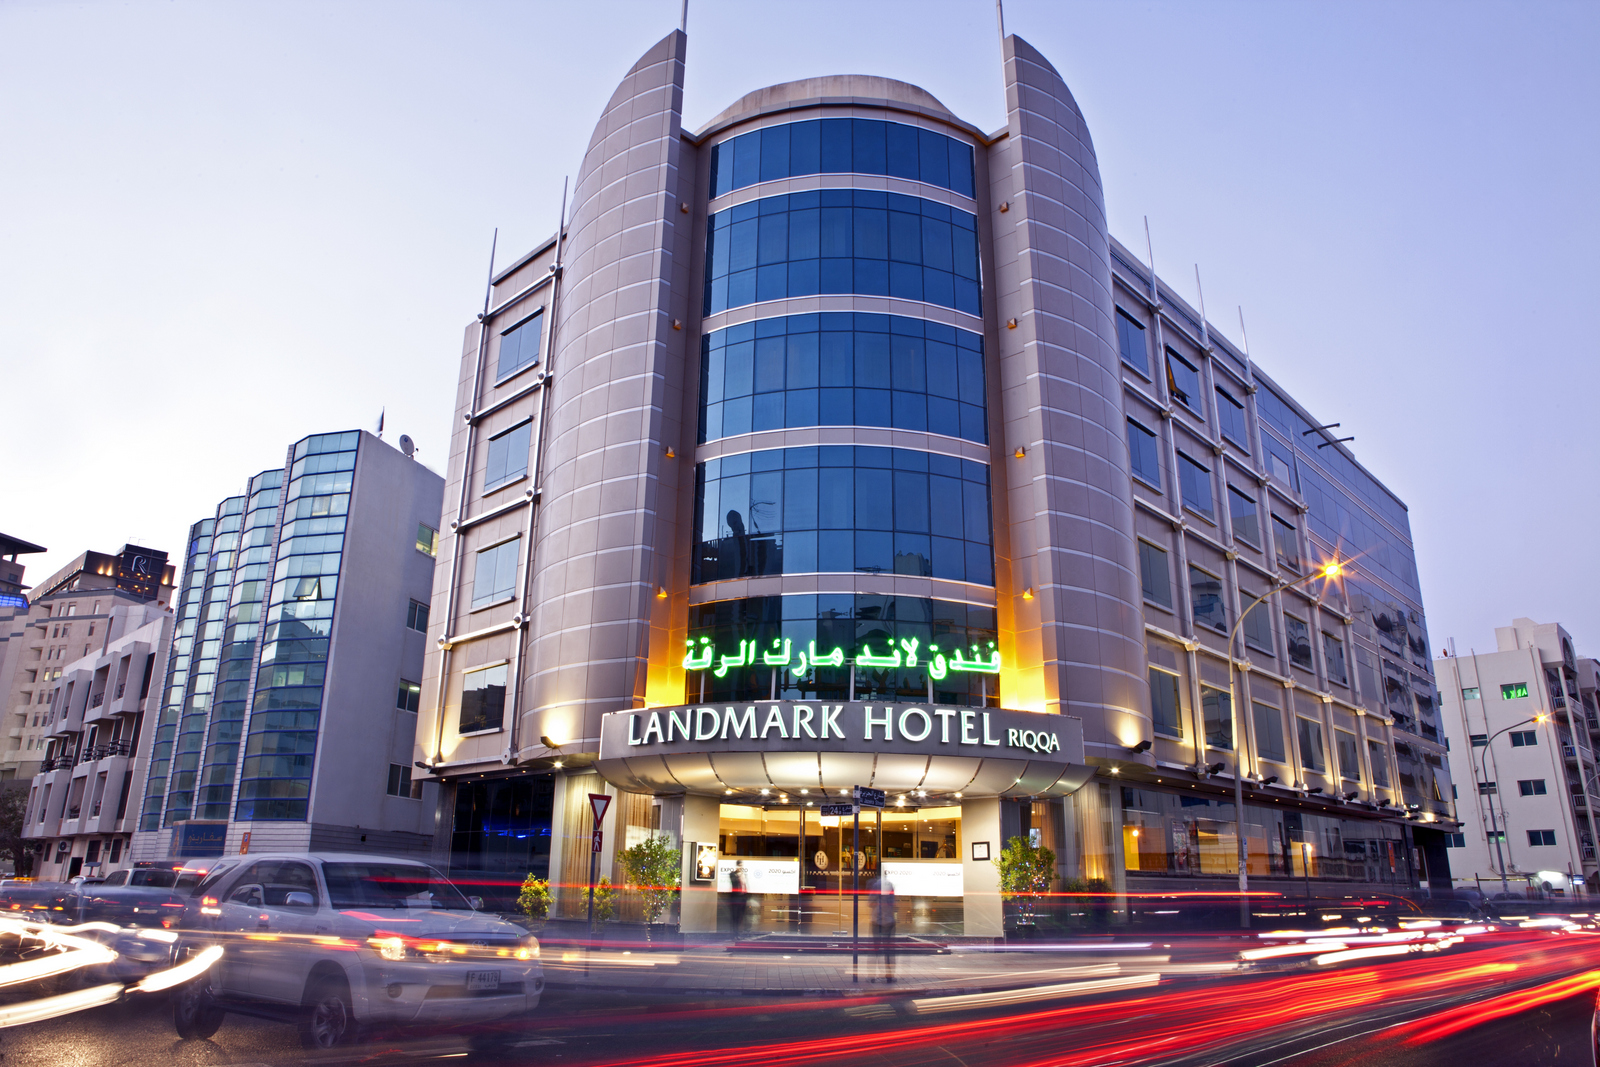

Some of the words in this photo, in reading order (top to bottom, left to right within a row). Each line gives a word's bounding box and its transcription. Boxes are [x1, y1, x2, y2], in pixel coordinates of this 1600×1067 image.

[682, 636, 756, 678] الرقة
[763, 637, 844, 677] مارك
[856, 636, 919, 668] لاند
[929, 641, 1000, 680] فندق
[628, 705, 846, 746] LANDMARK
[863, 706, 1000, 746] HOTEL
[1006, 728, 1060, 753] RIQQA
[829, 806, 838, 815] 24
[470, 972, 476, 982] F
